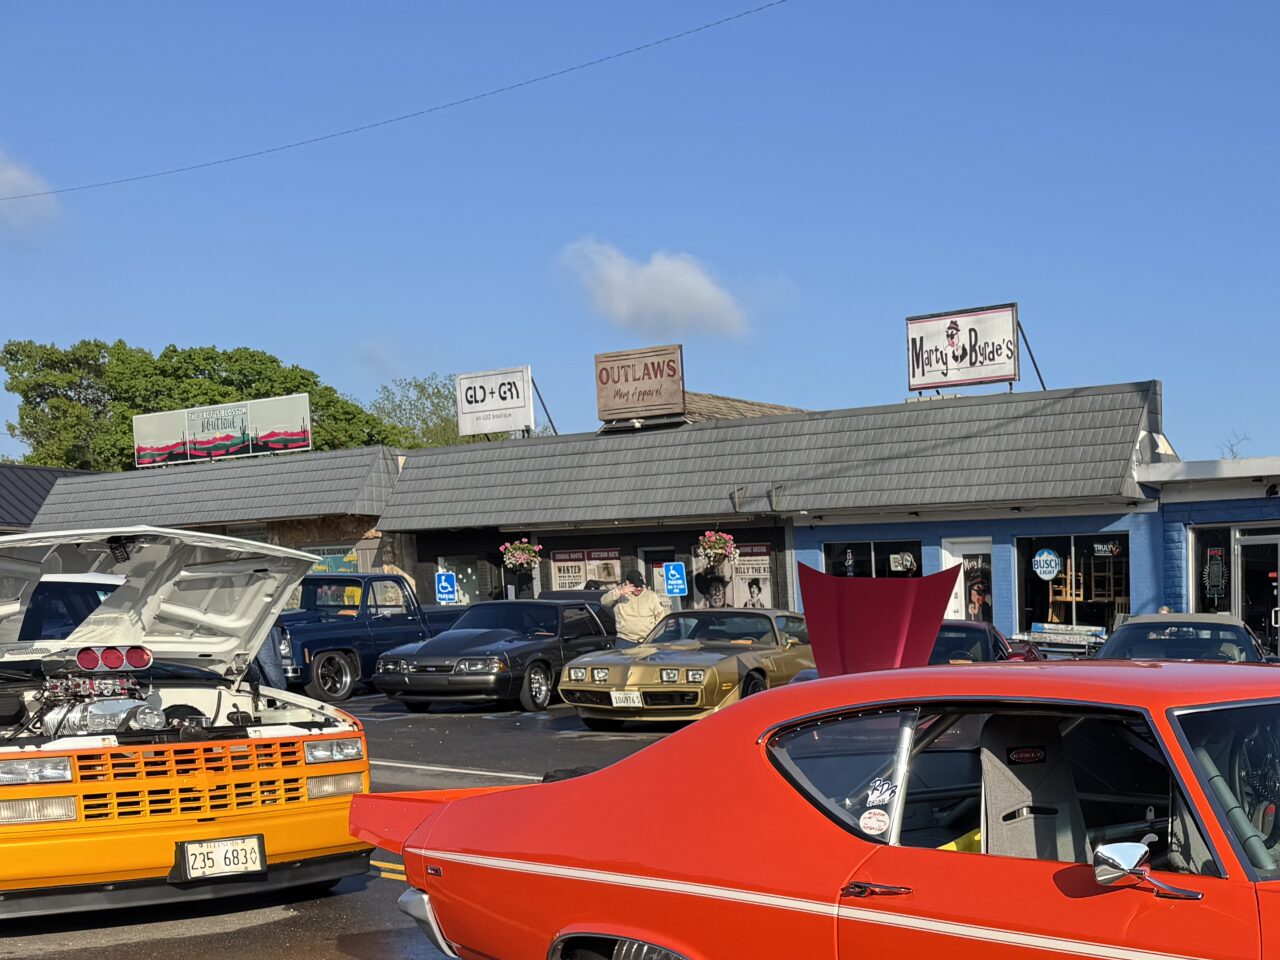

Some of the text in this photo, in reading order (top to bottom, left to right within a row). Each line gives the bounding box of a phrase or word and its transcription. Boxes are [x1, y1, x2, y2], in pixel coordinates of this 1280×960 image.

[911, 327, 1014, 378] Marty Byrde's
[598, 359, 677, 385] OUTLAWS
[631, 384, 663, 402] Apparel
[220, 407, 247, 417] BLOSSOM
[557, 565, 582, 575] WANTED
[735, 566, 749, 575] BILLY
[751, 566, 762, 574] THE
[1033, 559, 1060, 570] BUSCH
[190, 850, 215, 871] 235
[224, 848, 248, 867] 683
